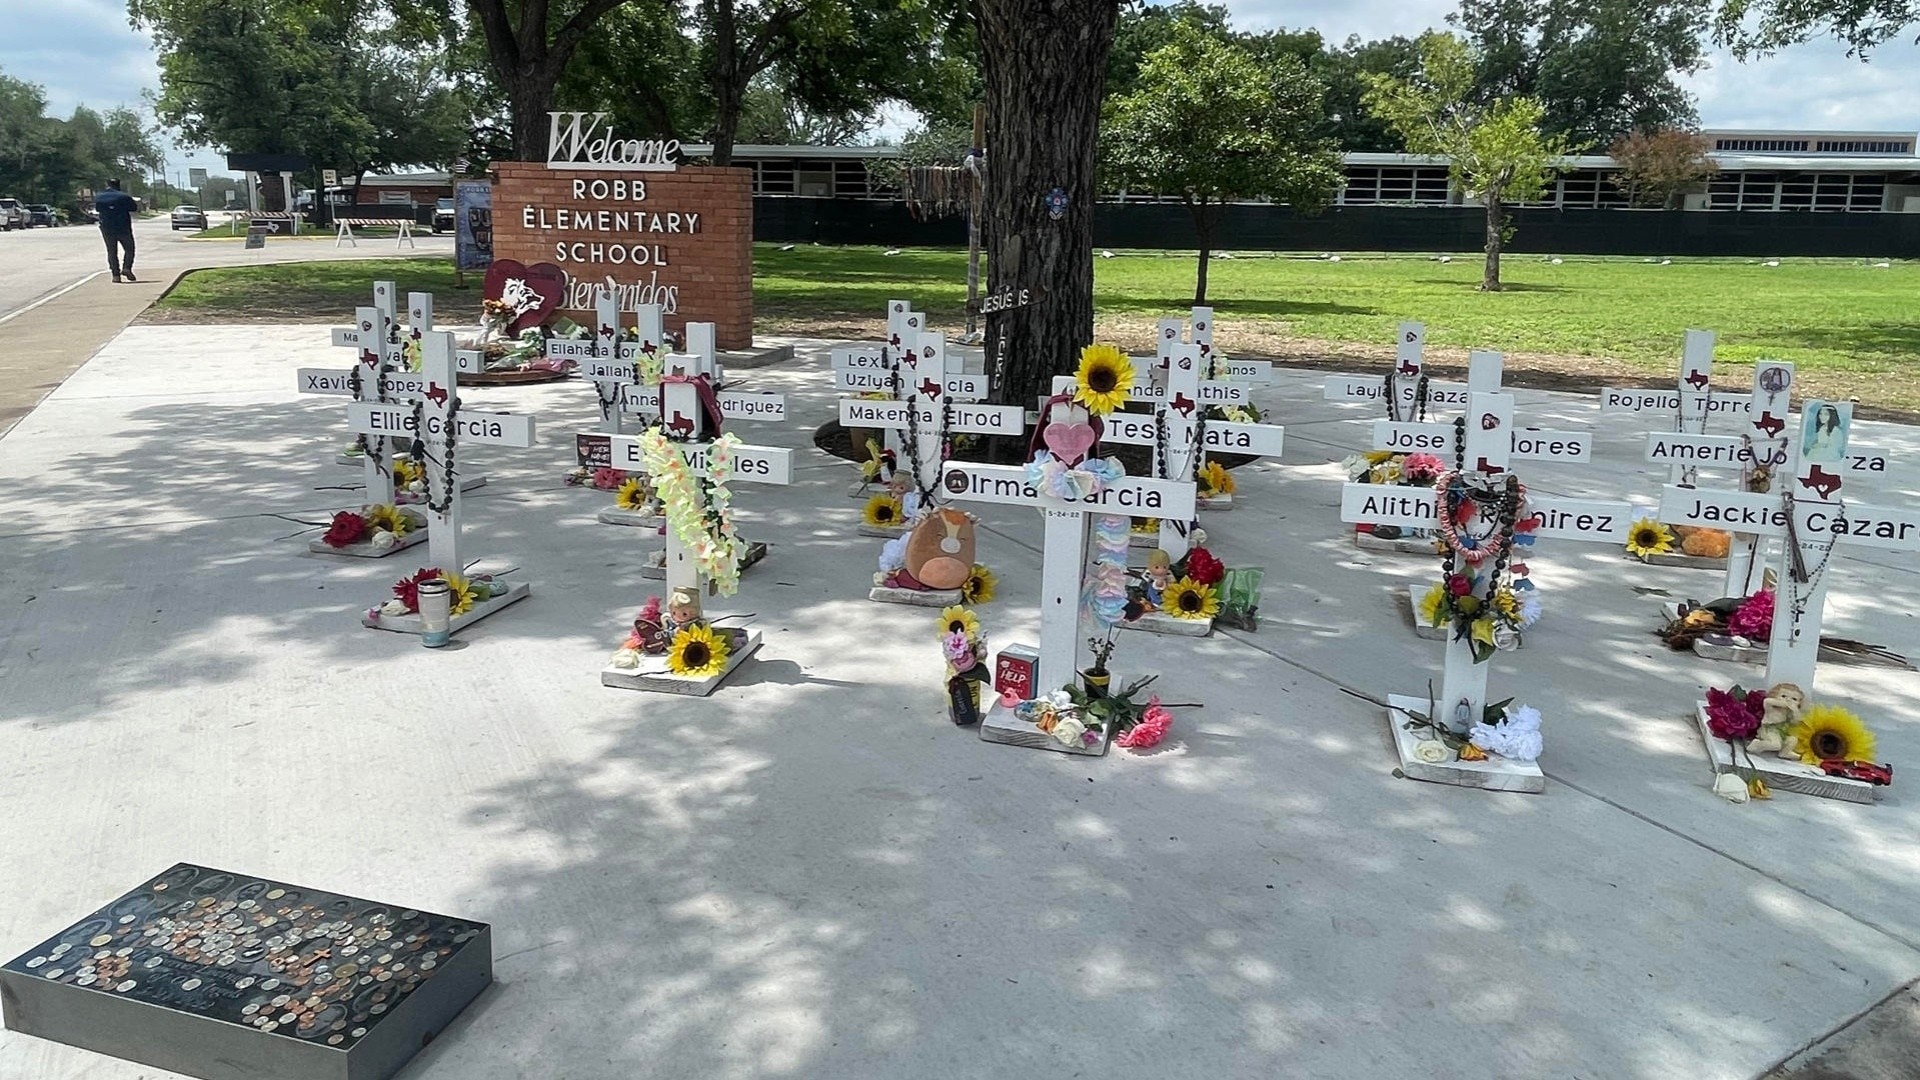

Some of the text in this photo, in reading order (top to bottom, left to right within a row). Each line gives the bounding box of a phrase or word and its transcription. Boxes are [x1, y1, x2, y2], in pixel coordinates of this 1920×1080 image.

[547, 112, 680, 164] Welcome
[573, 179, 646, 201] ROBB
[556, 242, 667, 266] SCHOOL
[980, 289, 1029, 314] JESUS IS
[848, 354, 887, 369] Lex
[308, 375, 364, 391] Xavie
[1347, 384, 1389, 399] Layl
[1695, 398, 1751, 412] Torre
[370, 411, 502, 438] Ellie Grcia
[1386, 429, 1582, 455] Jose lores
[1652, 441, 1787, 464] Amerie Jo
[682, 450, 769, 475] Miles
[1063, 486, 1162, 508] arcia
[1362, 496, 1438, 520] Alithi
[1687, 500, 1920, 540] Jackie Cazar
[1000, 669, 1027, 684] HELP
